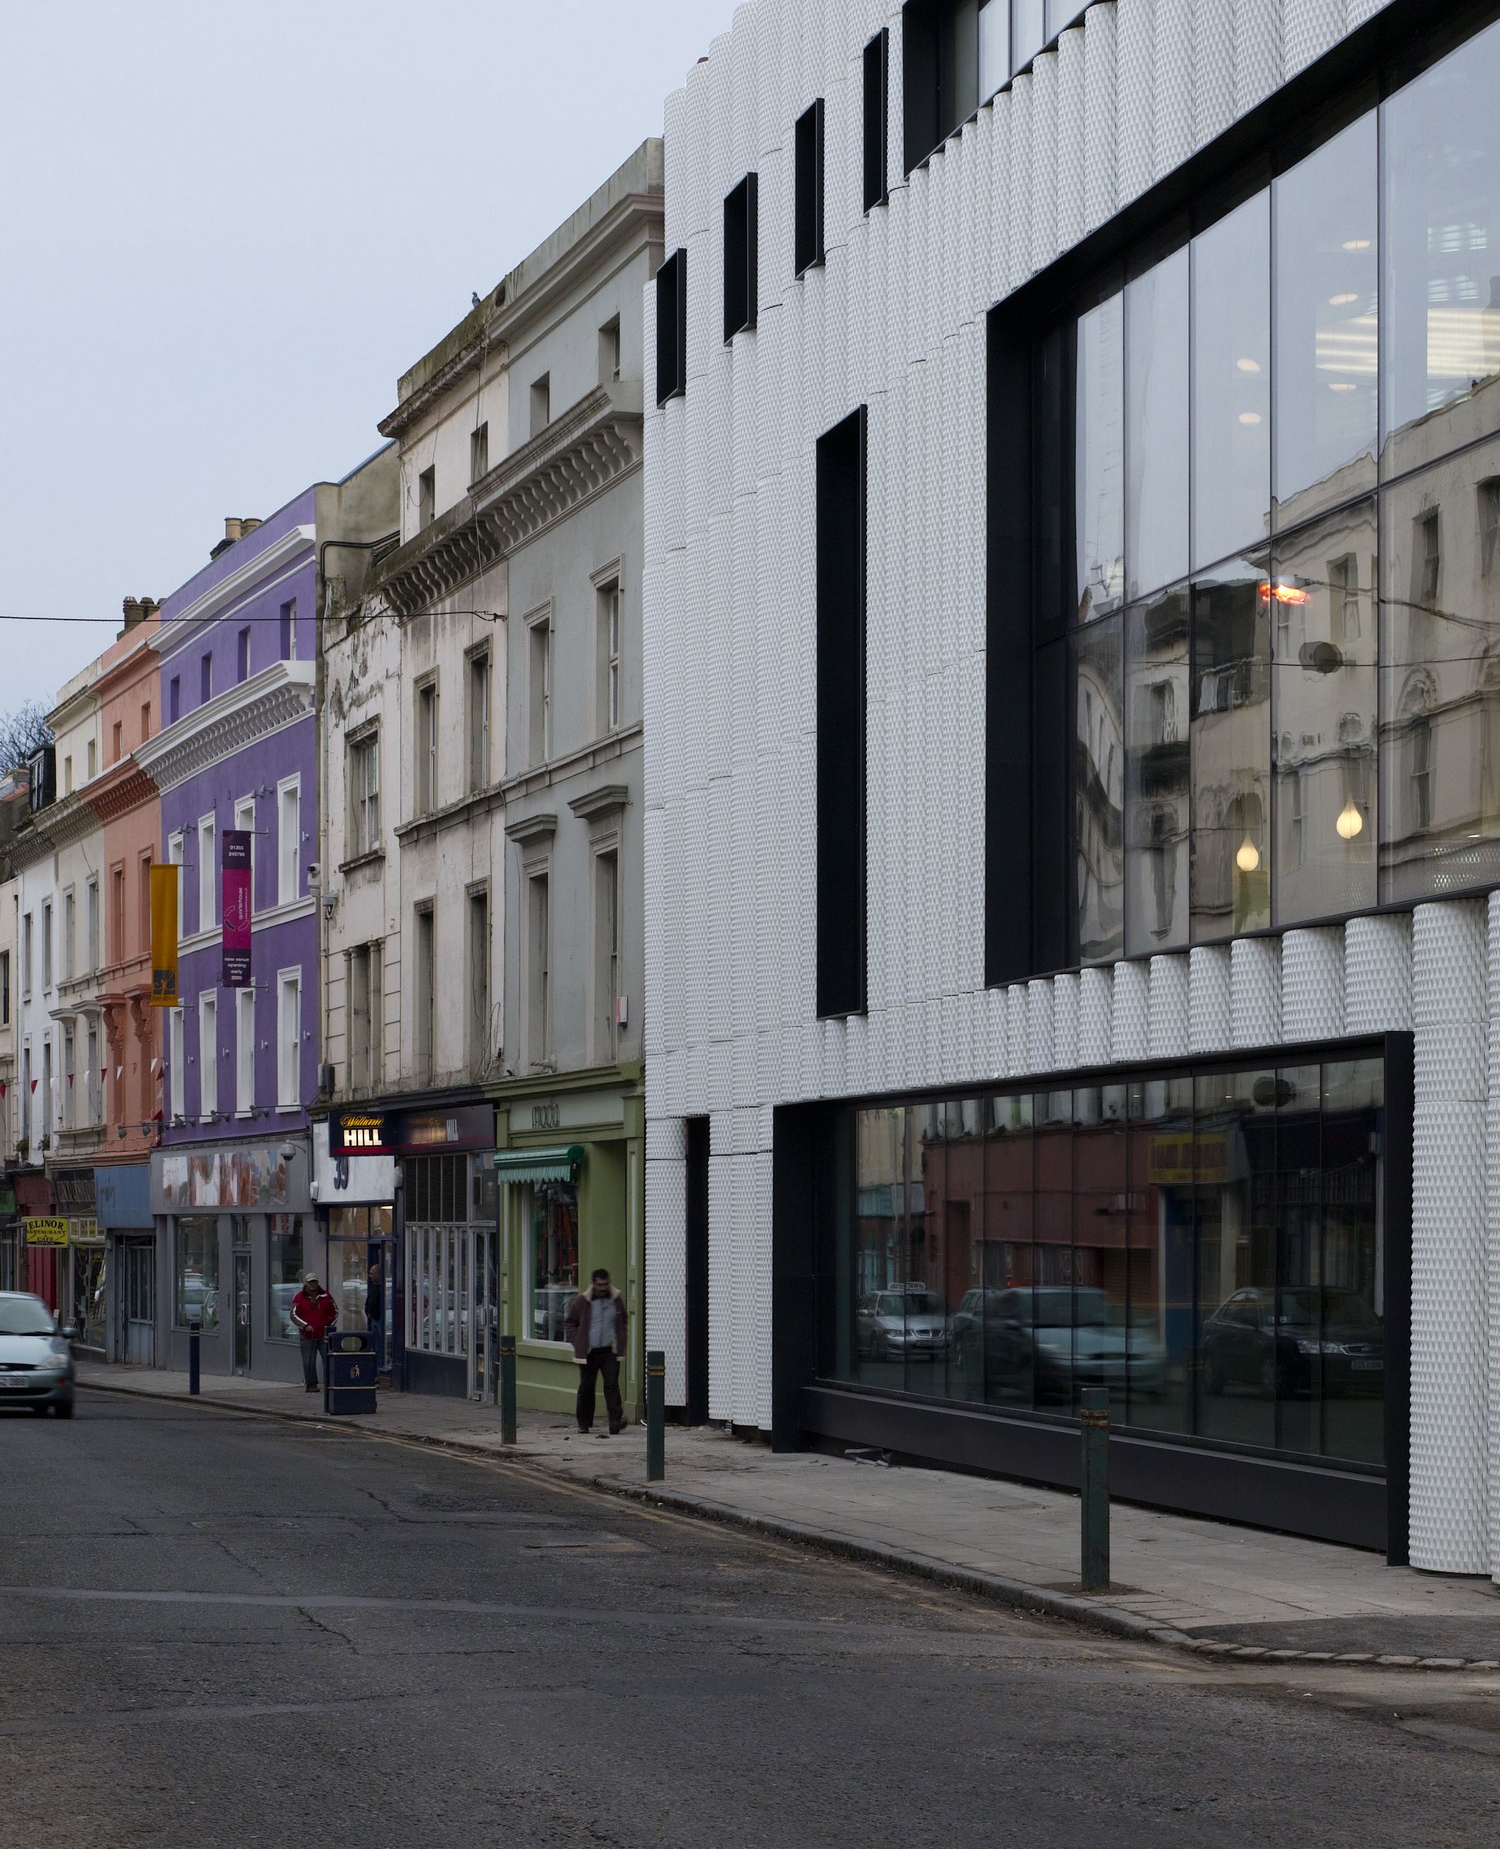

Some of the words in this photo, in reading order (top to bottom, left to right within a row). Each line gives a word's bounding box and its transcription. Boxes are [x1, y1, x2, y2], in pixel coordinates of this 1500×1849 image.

[340, 1114, 384, 1129] William
[343, 1129, 383, 1147] HILL
[28, 1219, 64, 1231] ELINOR
